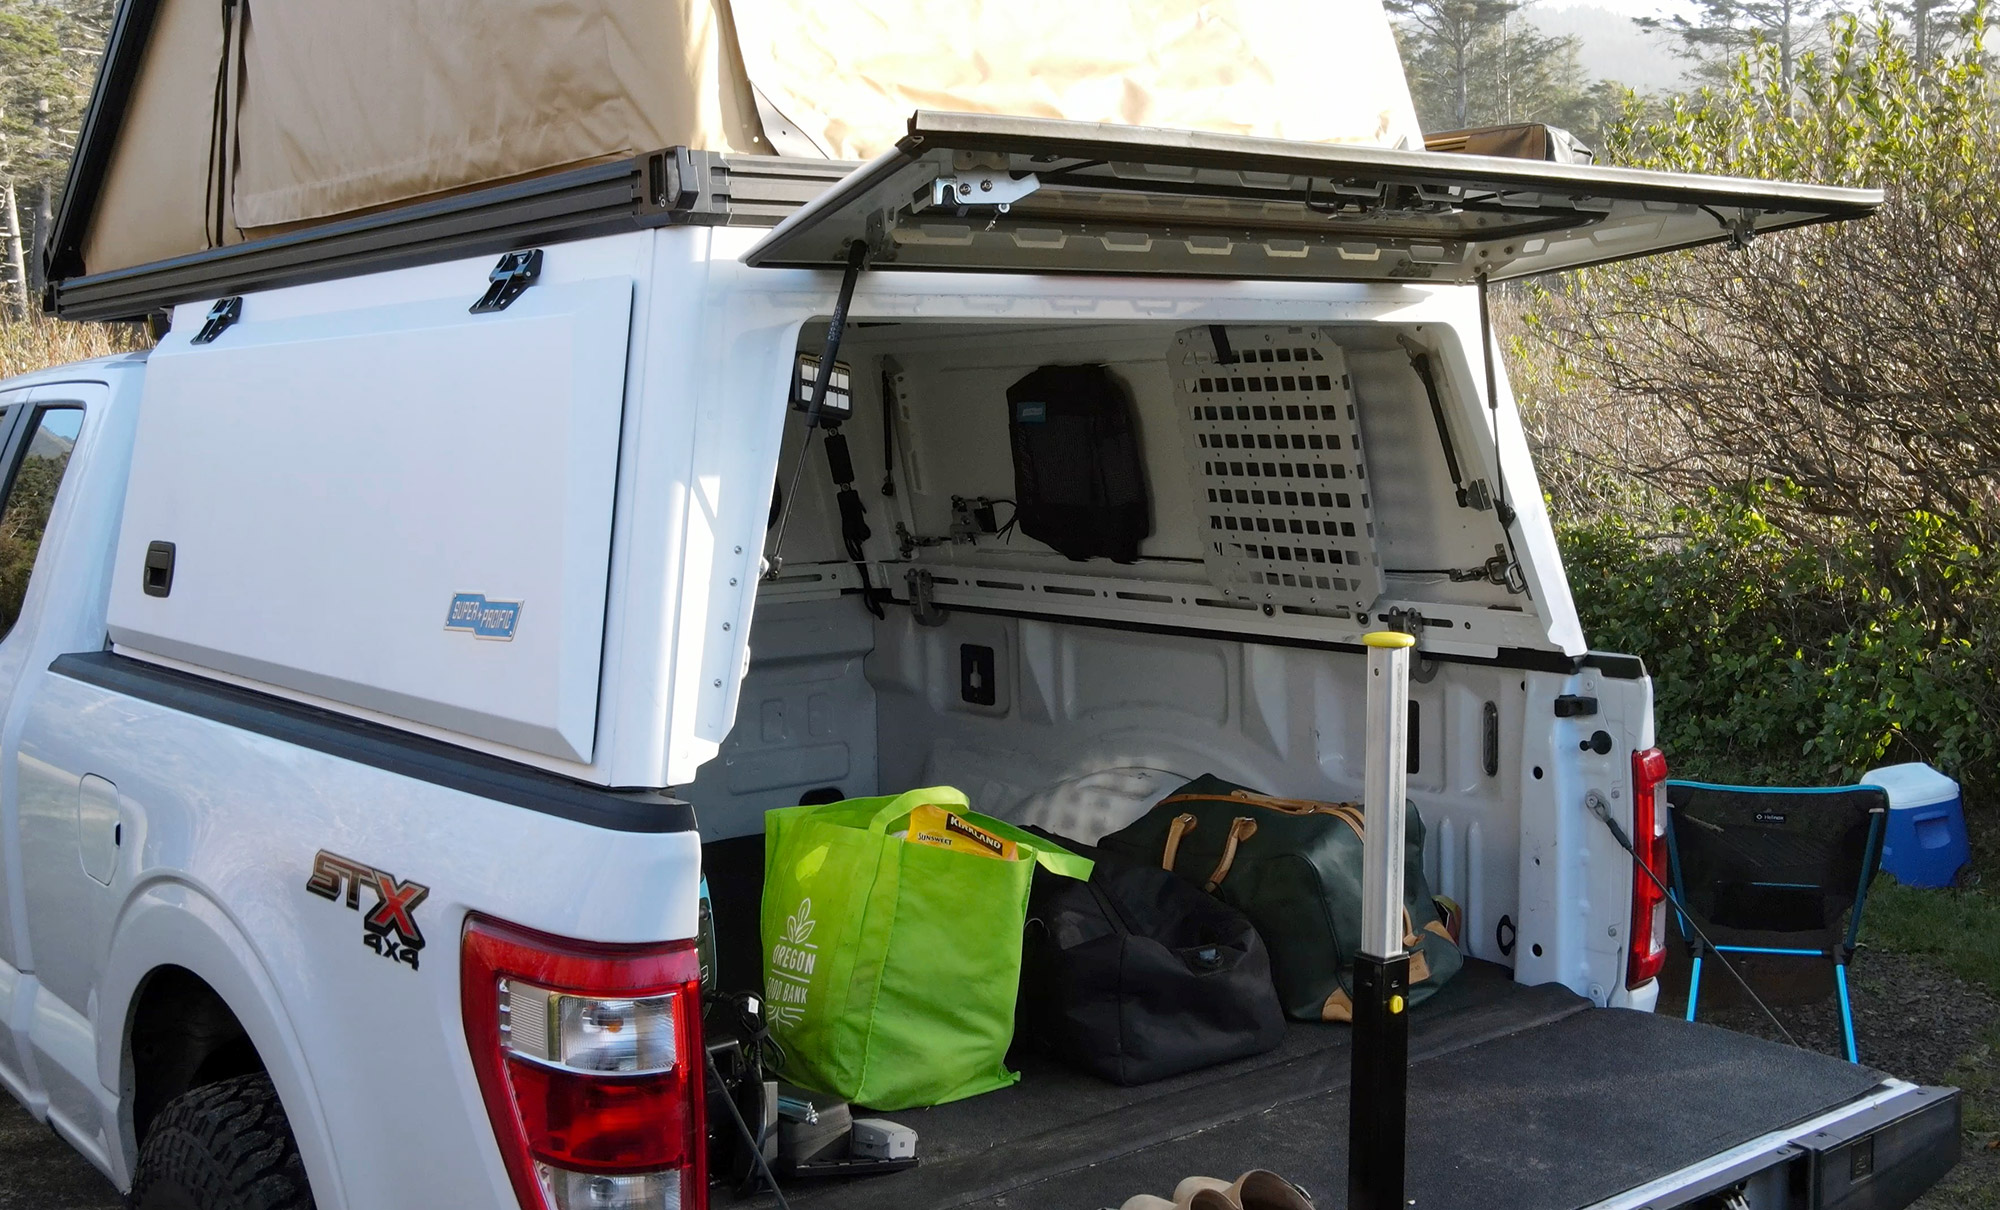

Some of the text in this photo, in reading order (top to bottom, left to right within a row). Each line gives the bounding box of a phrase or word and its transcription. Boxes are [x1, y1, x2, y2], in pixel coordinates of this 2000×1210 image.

[452, 601, 514, 630] SUPER PACIFIC
[917, 831, 953, 846] SUNSWEET
[949, 815, 1003, 850] KIRKLAND
[306, 848, 430, 951] STX
[772, 943, 817, 975] OREGON
[765, 976, 808, 1004] FOOD BANK
